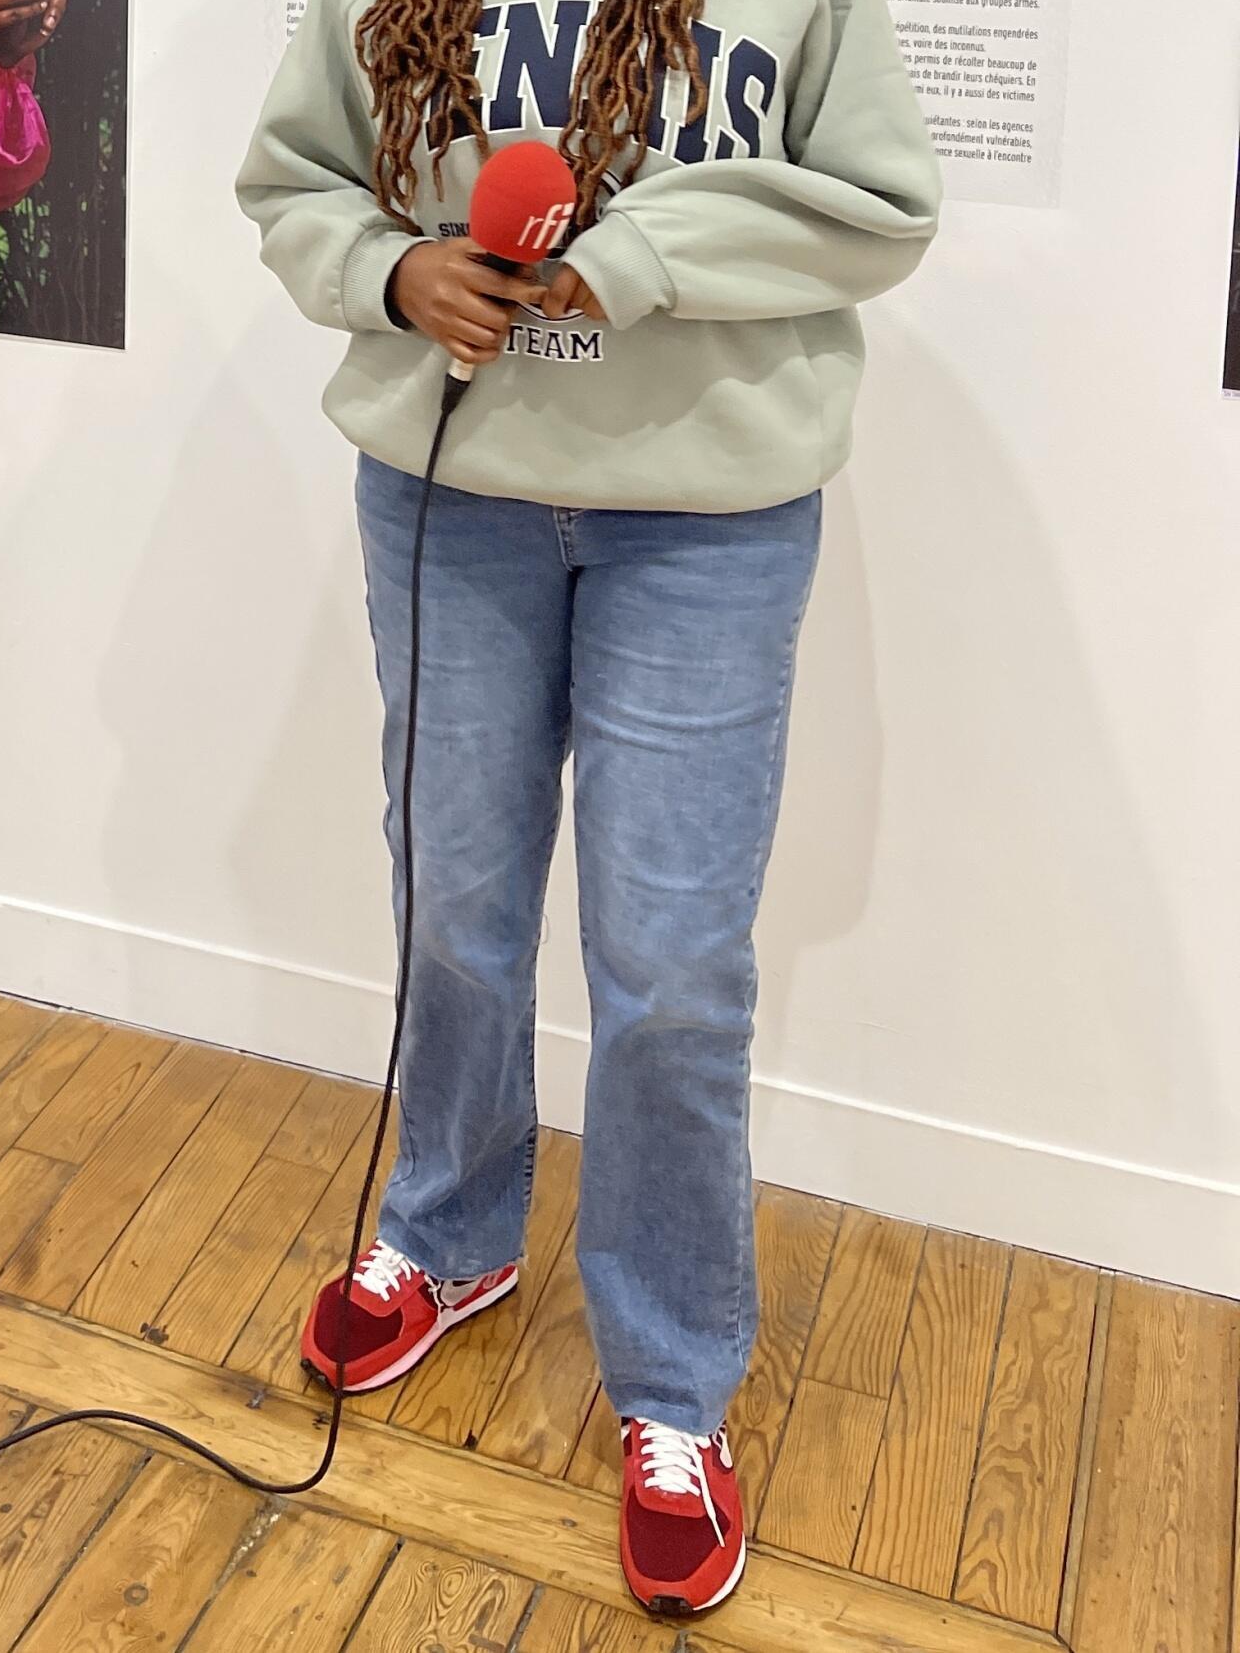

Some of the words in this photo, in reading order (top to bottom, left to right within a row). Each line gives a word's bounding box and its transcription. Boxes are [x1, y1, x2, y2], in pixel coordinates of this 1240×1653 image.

[933, 24, 946, 34] des
[948, 25, 991, 37] mutilations
[993, 28, 1038, 39] engendrées
[913, 39, 932, 49] voire
[934, 40, 947, 50] des
[949, 40, 986, 52] inconnus.
[914, 55, 940, 65] permis
[942, 55, 952, 65] de
[954, 56, 984, 67] récolter
[987, 58, 1024, 71] beaucoup
[1027, 60, 1037, 70] de
[922, 70, 931, 80] de
[933, 70, 960, 82] brandir
[963, 72, 982, 83] leurs
[984, 74, 1024, 86] chéquiers.
[1026, 76, 1036, 86] En
[926, 87, 942, 96] eux,
[943, 86, 948, 96] il
[951, 88, 956, 98] y
[958, 89, 962, 97] a
[964, 88, 984, 98] aussi
[986, 89, 1000, 99] des
[1002, 90, 1035, 101] victimes
[966, 119, 987, 129] selon
[989, 120, 1000, 130] les
[1002, 123, 1034, 132] agences
[986, 136, 1032, 149] vulnérables,
[954, 149, 985, 160] sexuelle
[987, 150, 992, 160] à
[993, 151, 1032, 163] l'encontre
[517, 202, 575, 250] rfi
[505, 324, 603, 362] TEAM
